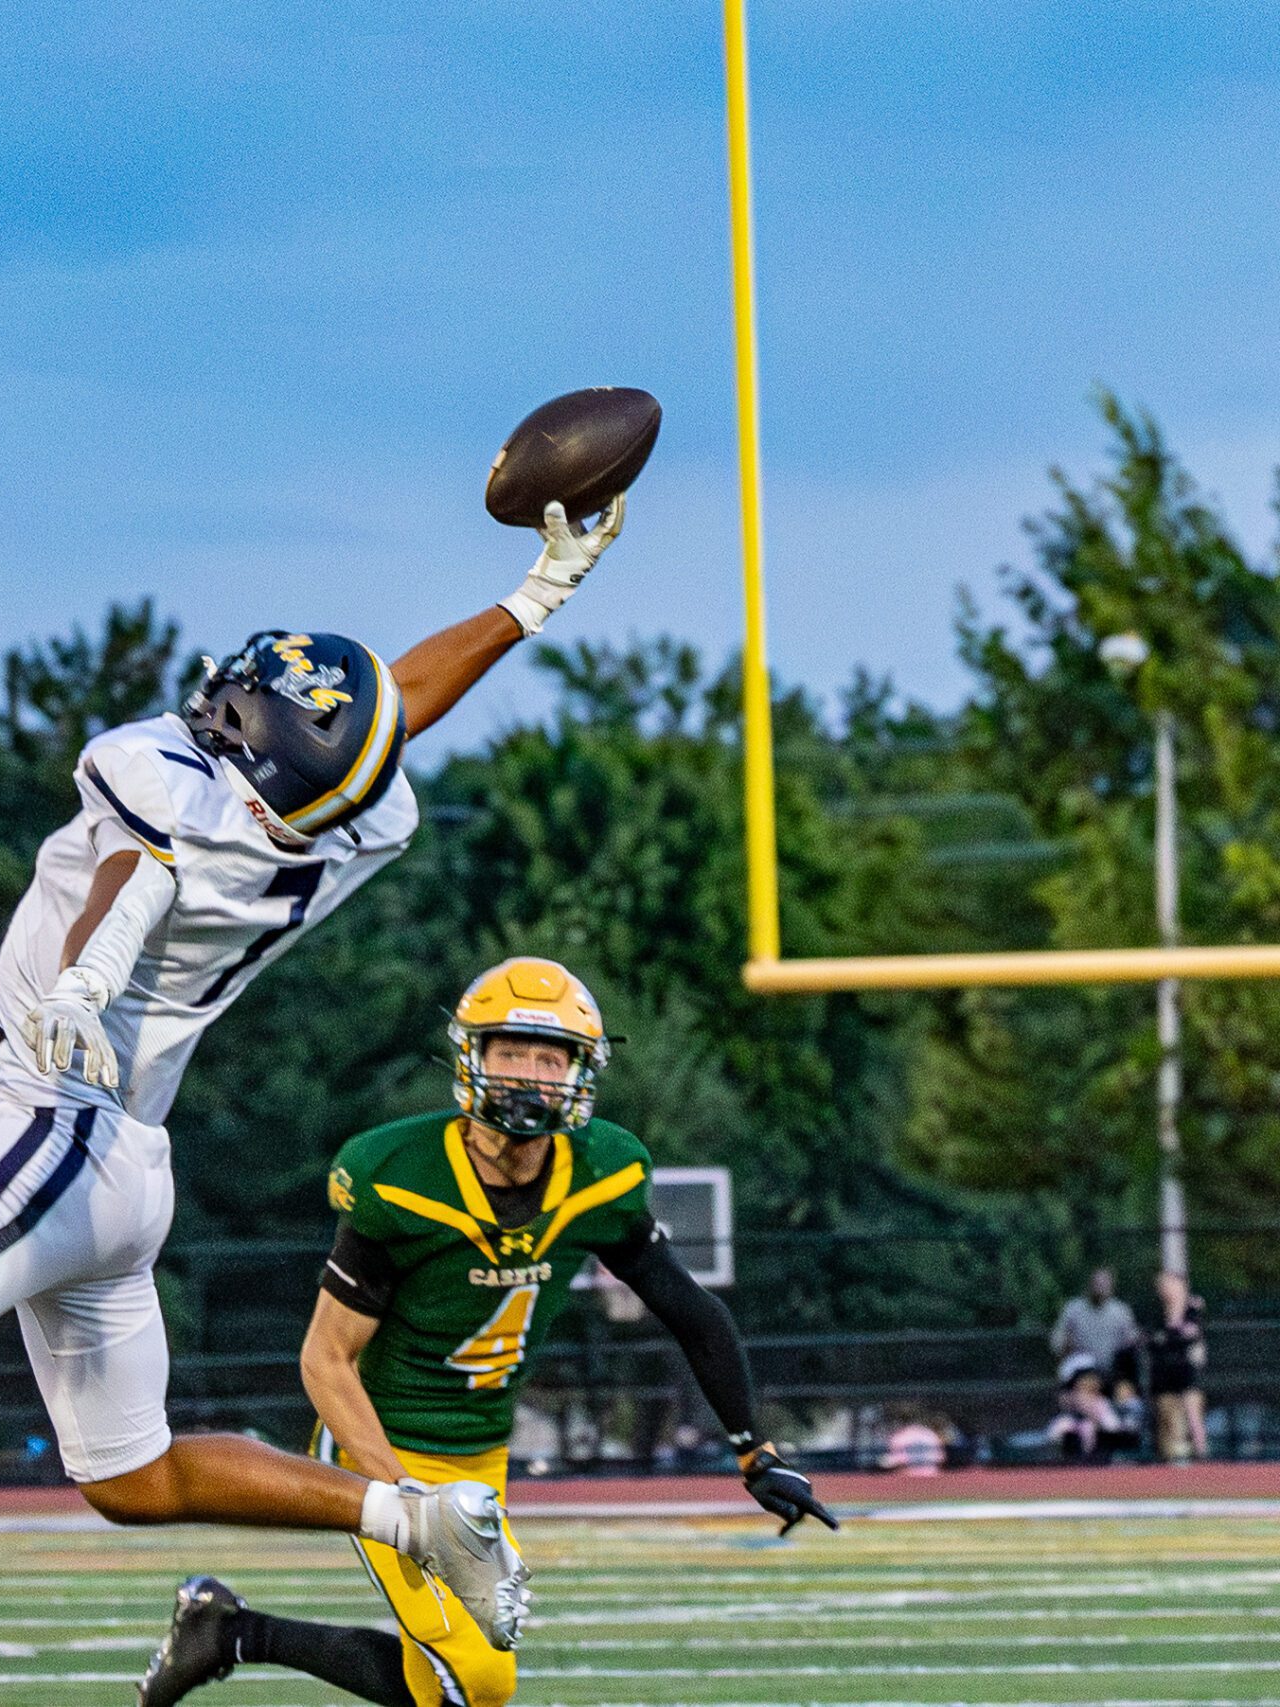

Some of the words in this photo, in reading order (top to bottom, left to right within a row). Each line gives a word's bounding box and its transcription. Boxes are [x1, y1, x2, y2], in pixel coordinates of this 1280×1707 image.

[157, 747, 216, 780] 7
[189, 860, 327, 1007] 7
[444, 1283, 540, 1390] 4
